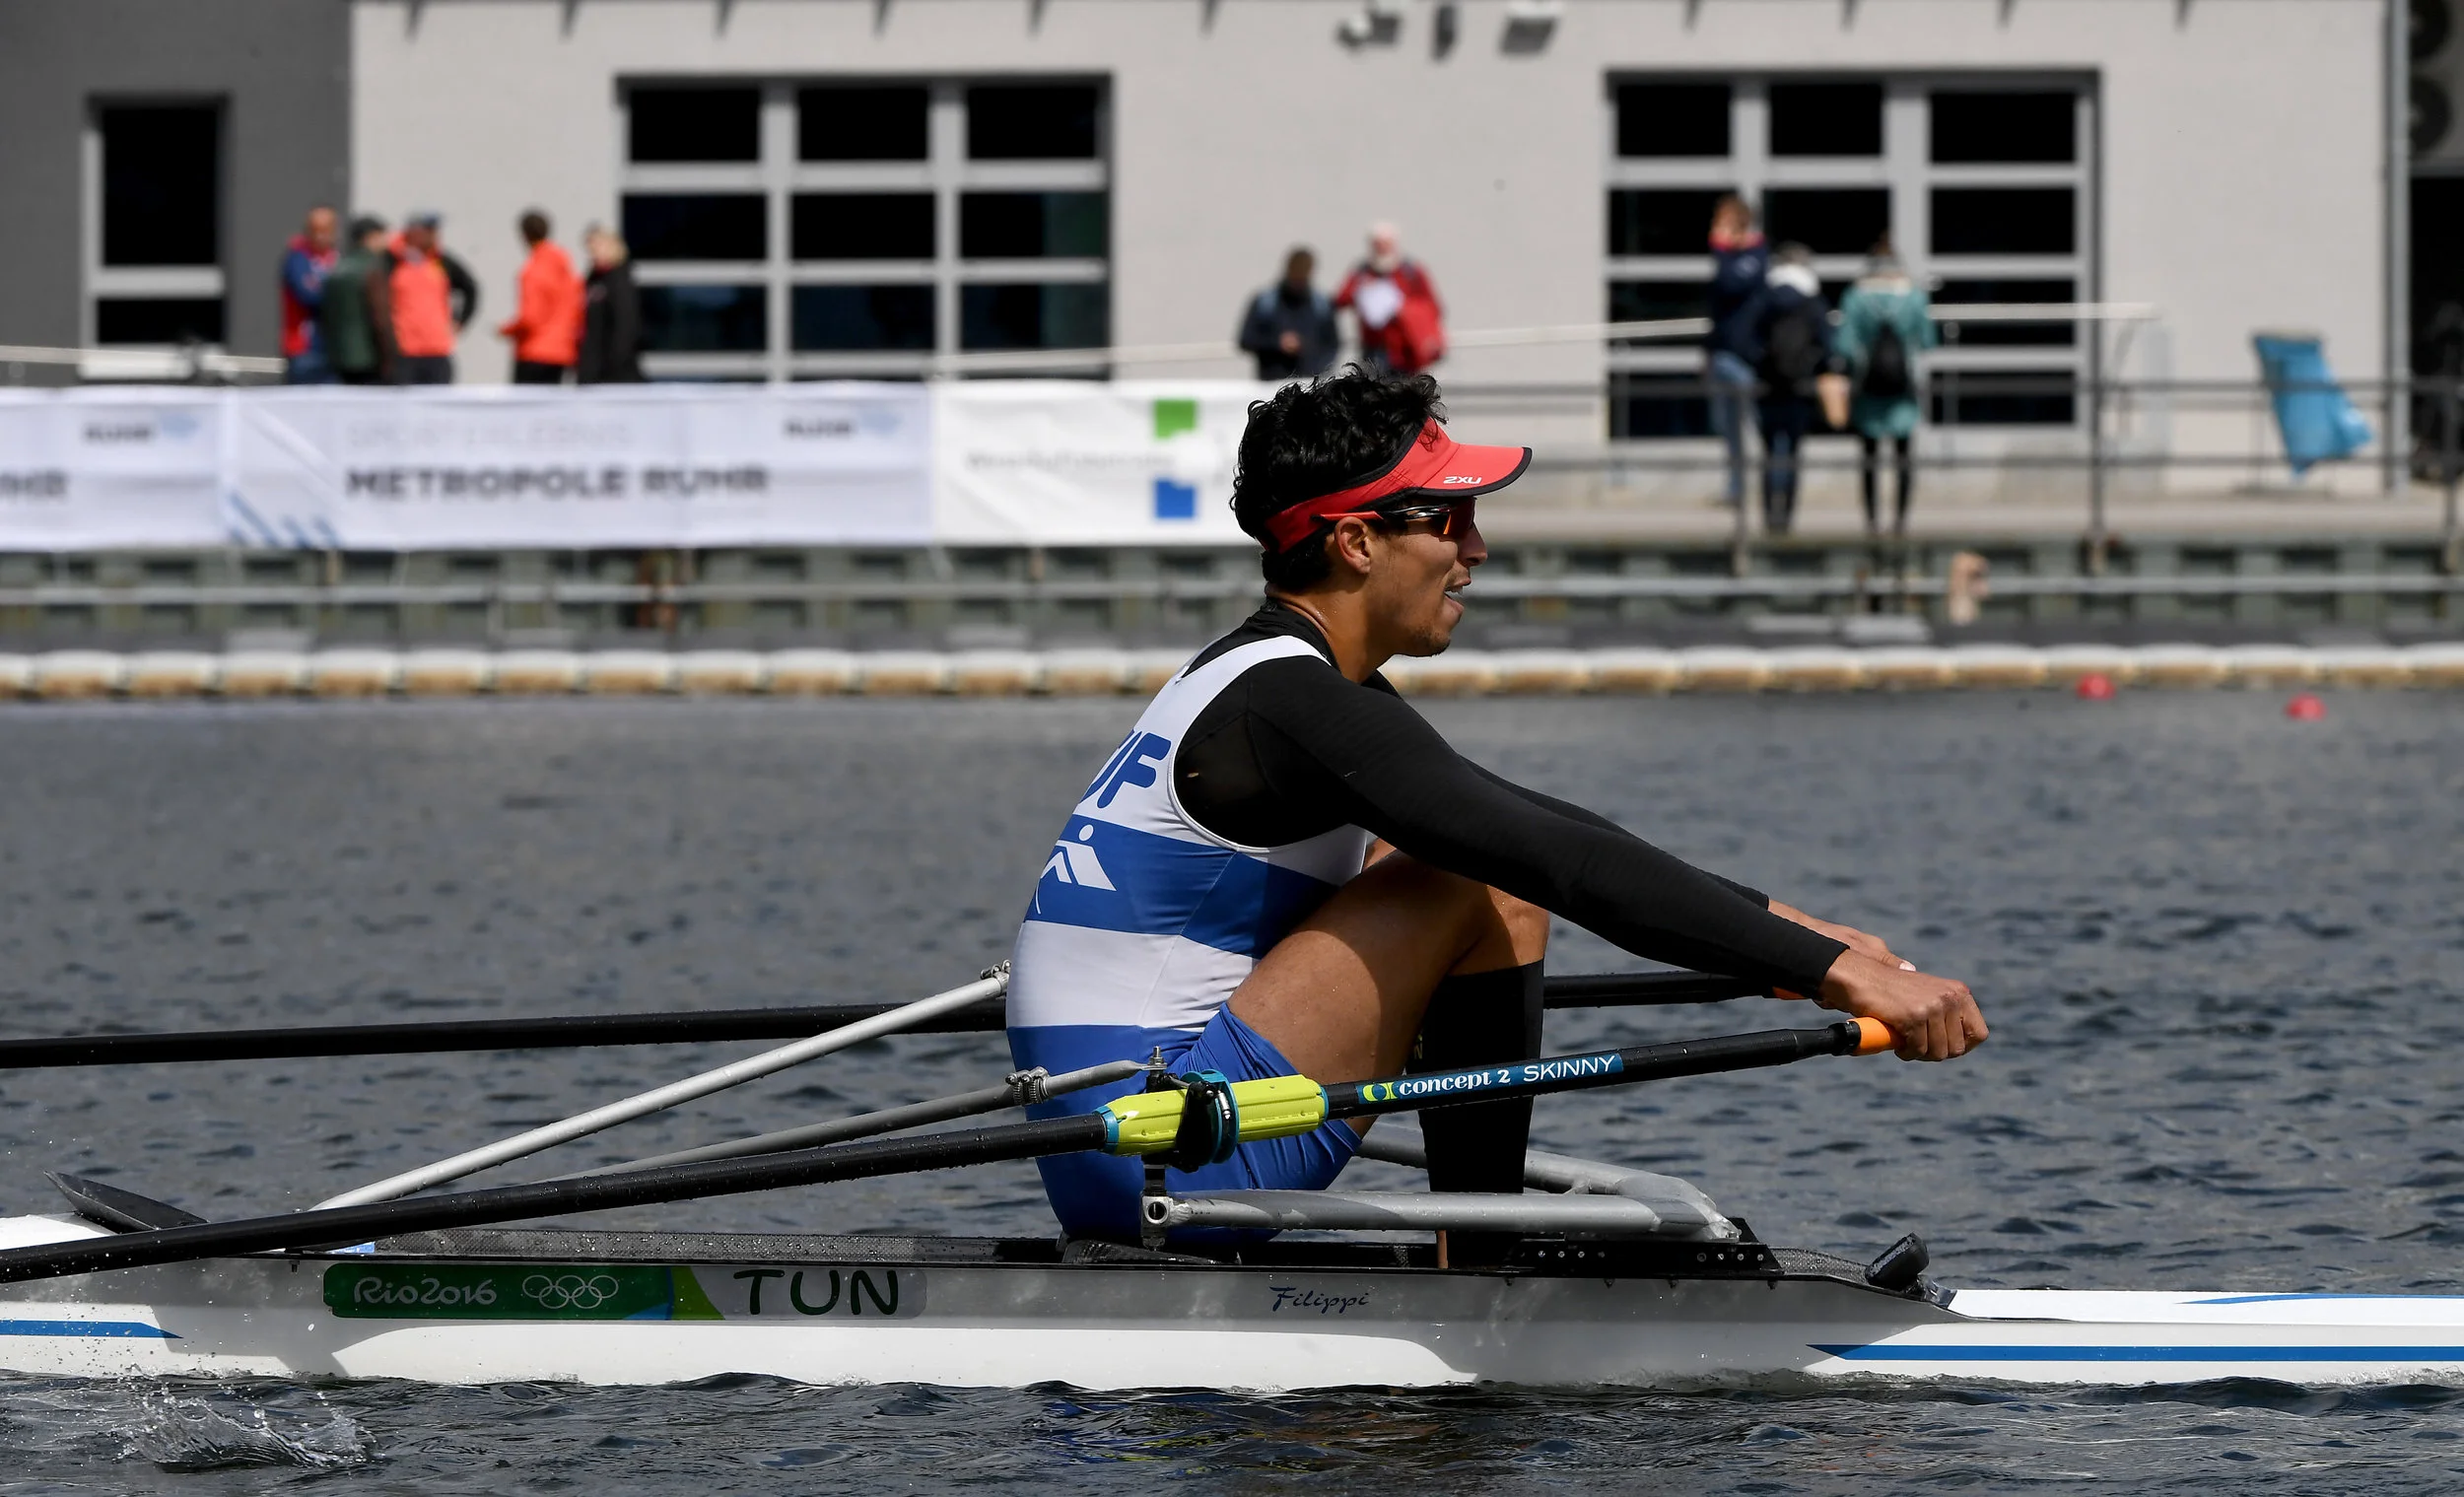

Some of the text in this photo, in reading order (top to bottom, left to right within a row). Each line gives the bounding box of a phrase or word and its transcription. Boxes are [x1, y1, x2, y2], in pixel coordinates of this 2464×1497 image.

[346, 463, 769, 498] METROPOLE RUHR
[1442, 476, 1483, 485] 2XU
[1399, 1055, 1615, 1096] concept 2 SKINNY
[733, 1269, 899, 1316] TUN
[1268, 1286, 1369, 1314] Filippi
